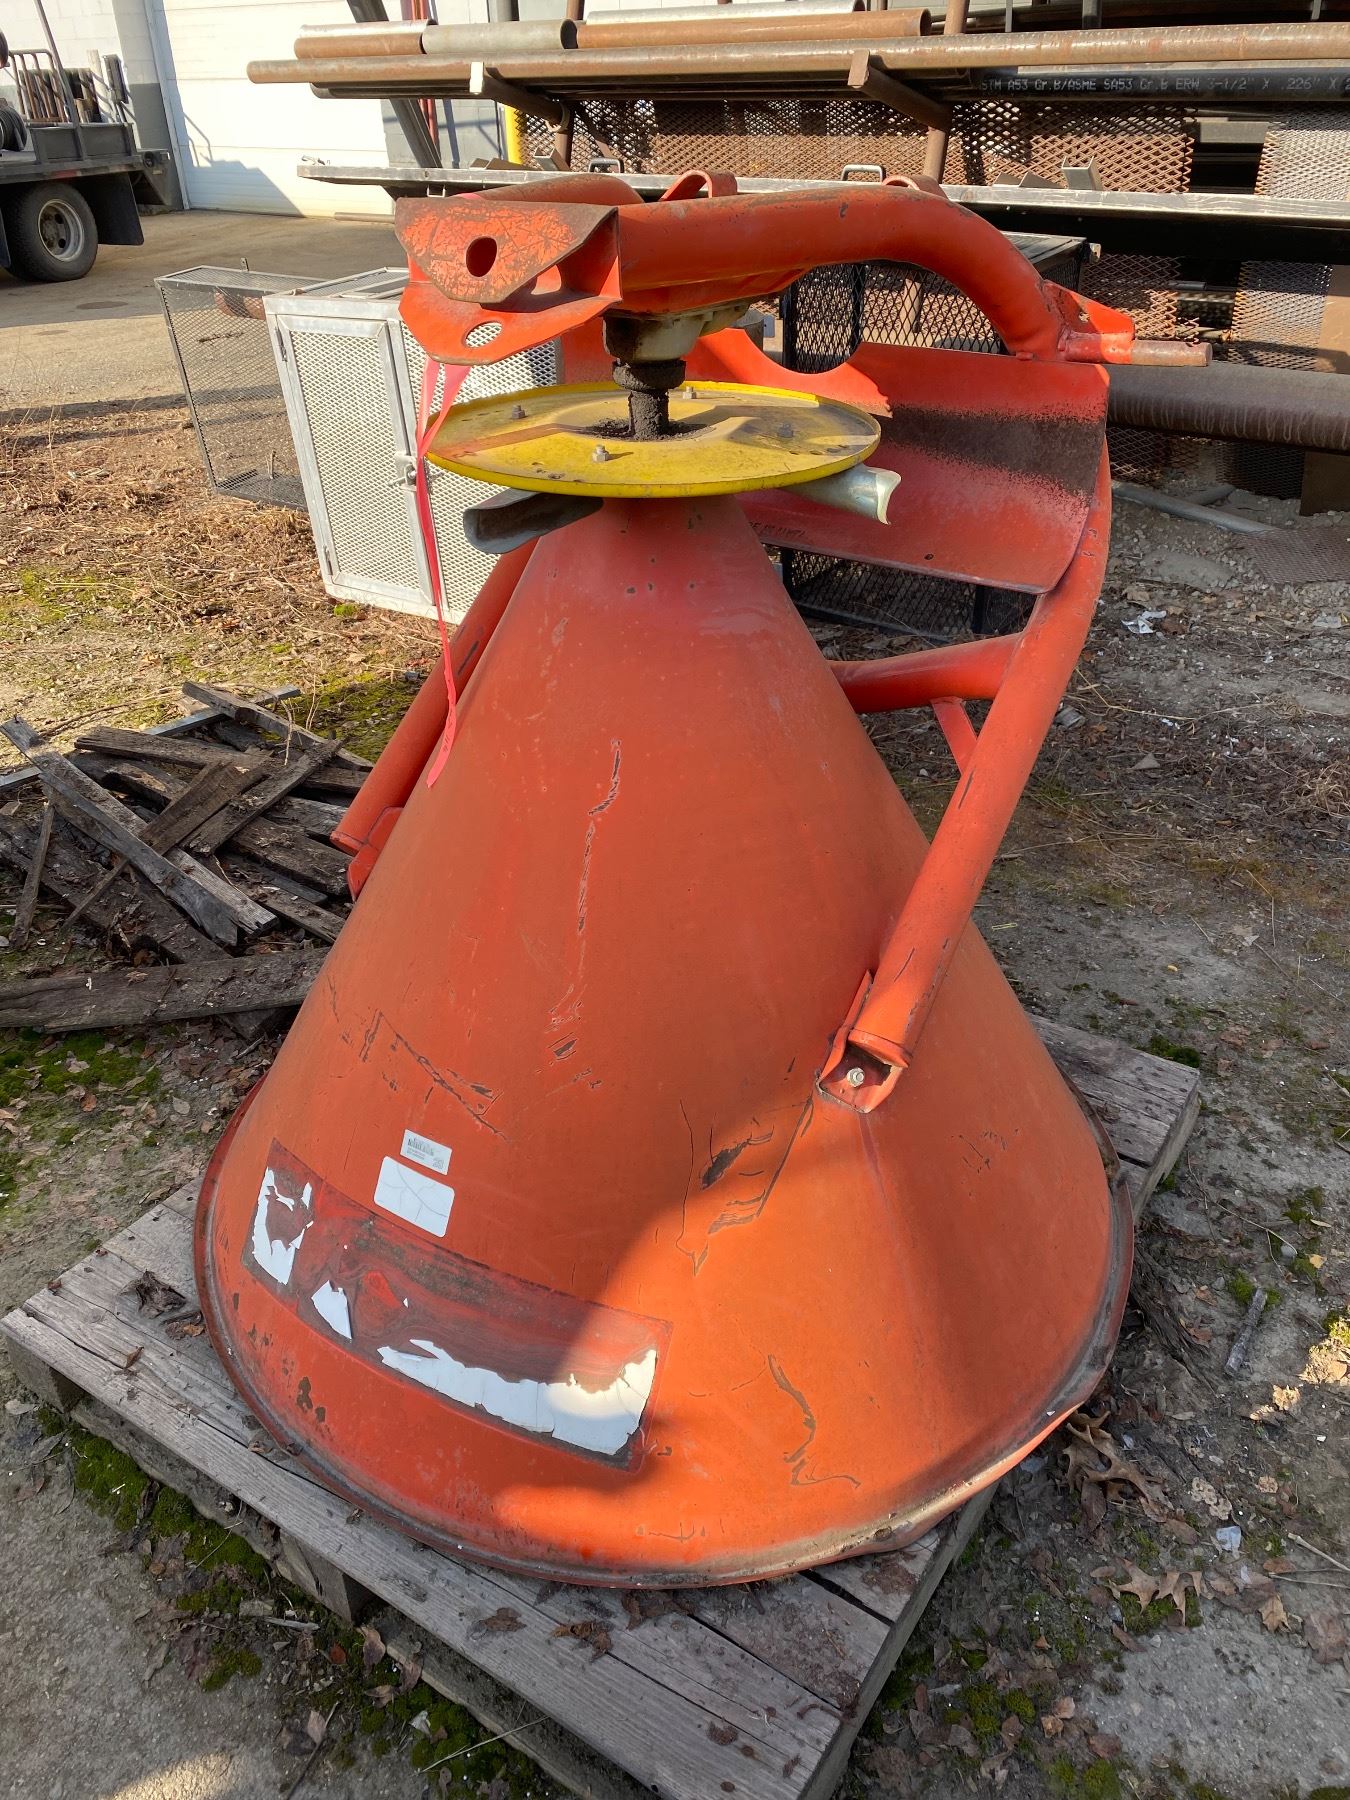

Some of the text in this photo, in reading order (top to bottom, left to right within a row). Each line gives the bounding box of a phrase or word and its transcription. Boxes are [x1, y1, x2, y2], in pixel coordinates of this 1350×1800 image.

[1007, 79, 1028, 91] A53
[1103, 78, 1133, 90] SA53
[1175, 77, 1200, 90] ERW
[1281, 77, 1321, 90] .226"
[1328, 77, 1338, 90] X
